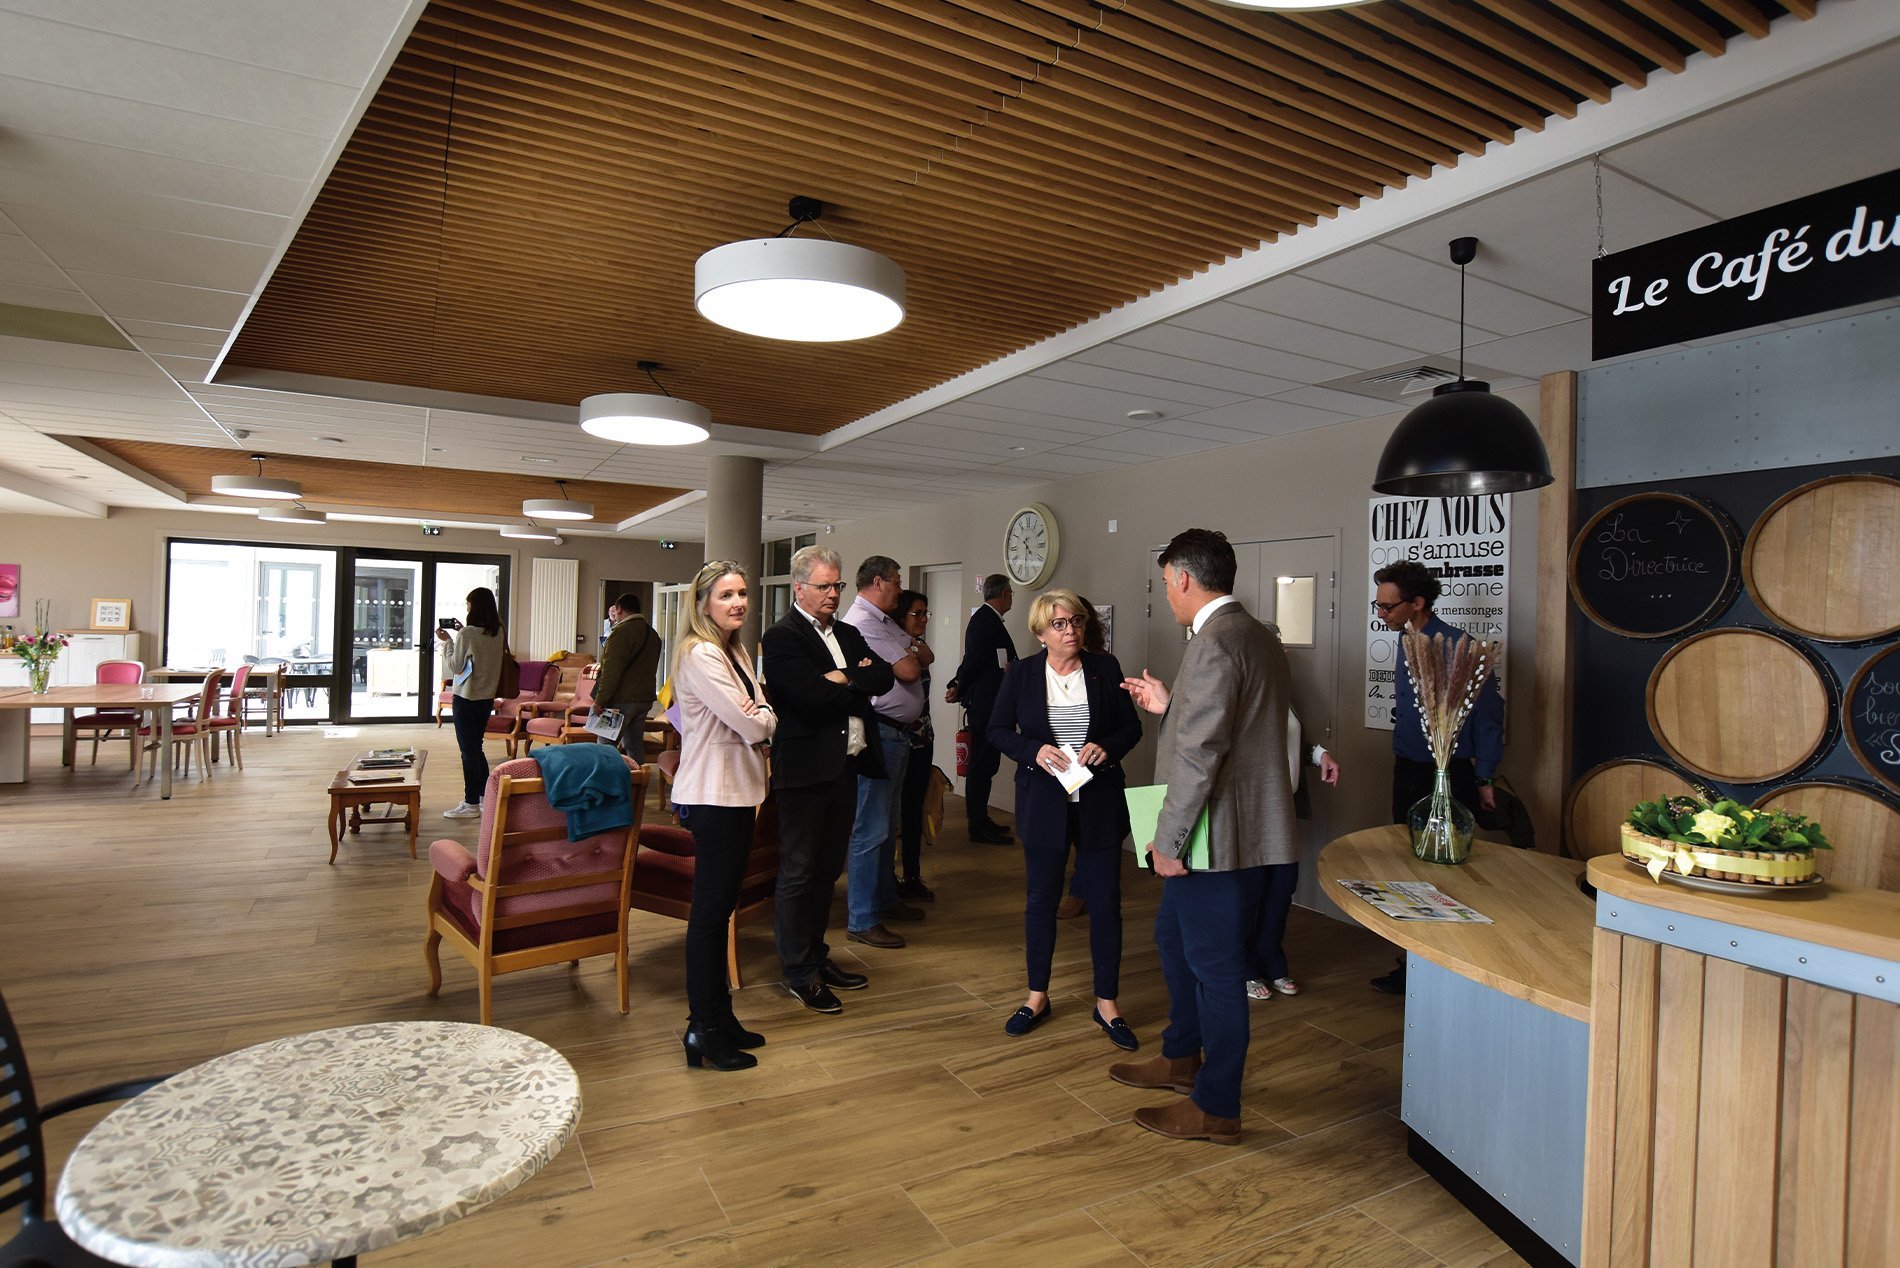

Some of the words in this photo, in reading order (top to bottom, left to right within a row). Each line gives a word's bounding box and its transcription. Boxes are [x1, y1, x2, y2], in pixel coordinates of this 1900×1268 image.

[1608, 276, 1669, 316] Le
[1687, 225, 1813, 301] Café
[1372, 499, 1429, 542] CHEZ
[1439, 495, 1505, 537] NOUS
[1598, 513, 1653, 543] La
[1408, 541, 1505, 561] s'amuse
[1599, 547, 1710, 581] Directrice
[1441, 607, 1503, 618] mensonges
[1368, 685, 1385, 698] On
[1368, 706, 1388, 719] on
